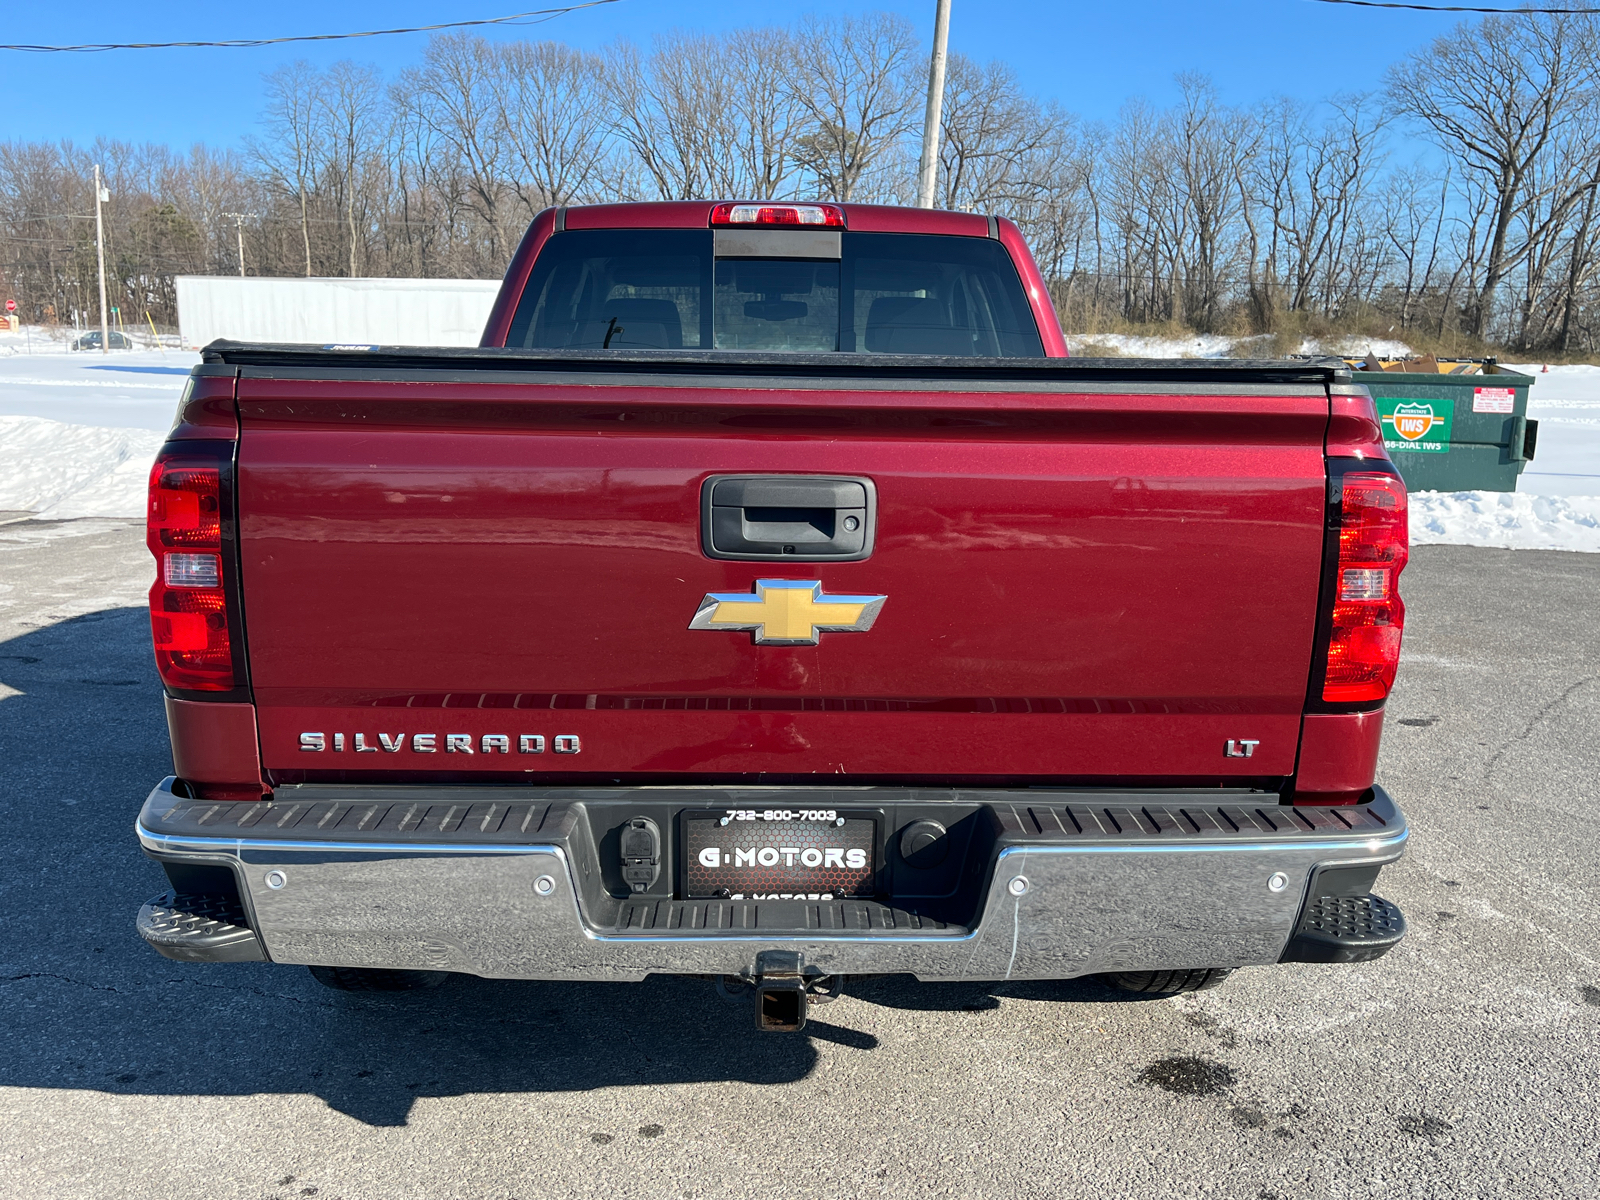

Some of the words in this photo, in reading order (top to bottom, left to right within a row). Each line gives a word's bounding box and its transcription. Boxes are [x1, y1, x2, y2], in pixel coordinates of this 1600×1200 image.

[1400, 419, 1424, 432] IWS
[1423, 442, 1442, 450] IWS
[299, 732, 581, 754] SILVERADO
[1224, 739, 1260, 758] LT
[726, 809, 837, 821] 732-800-7003
